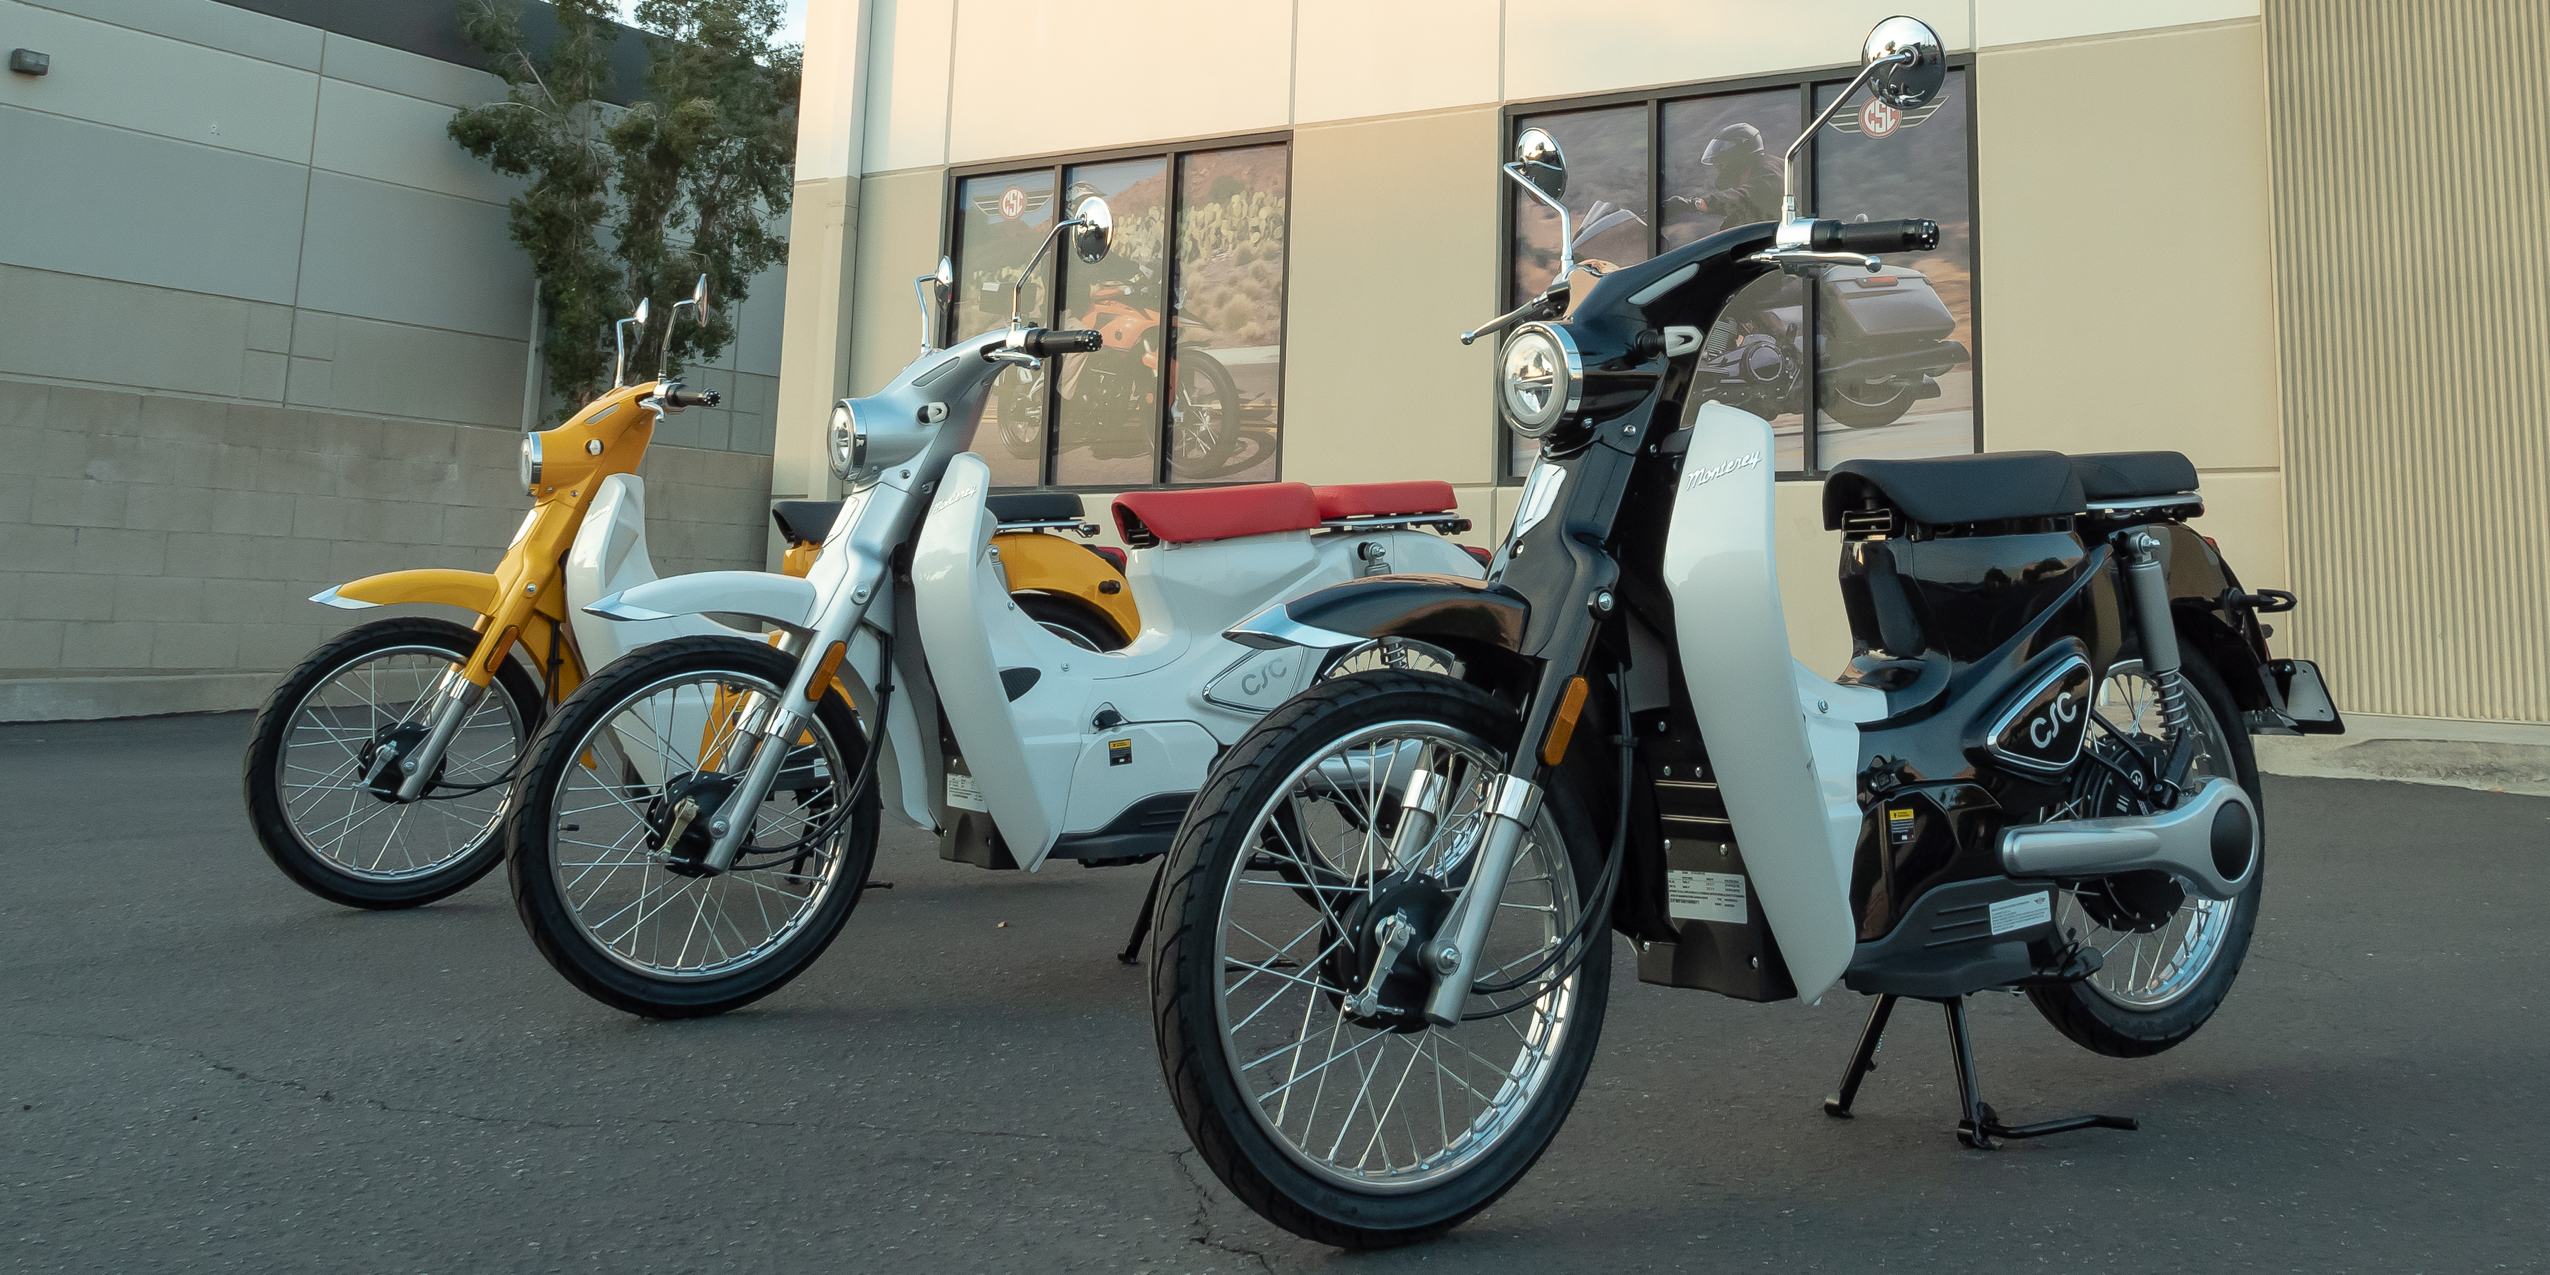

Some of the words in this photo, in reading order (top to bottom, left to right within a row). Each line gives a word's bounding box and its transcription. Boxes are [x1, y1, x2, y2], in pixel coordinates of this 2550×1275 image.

[1003, 189, 1024, 217] CSC
[1687, 451, 1762, 491] Monterey
[1241, 658, 1288, 696] CSC
[2030, 691, 2077, 749] CSC
